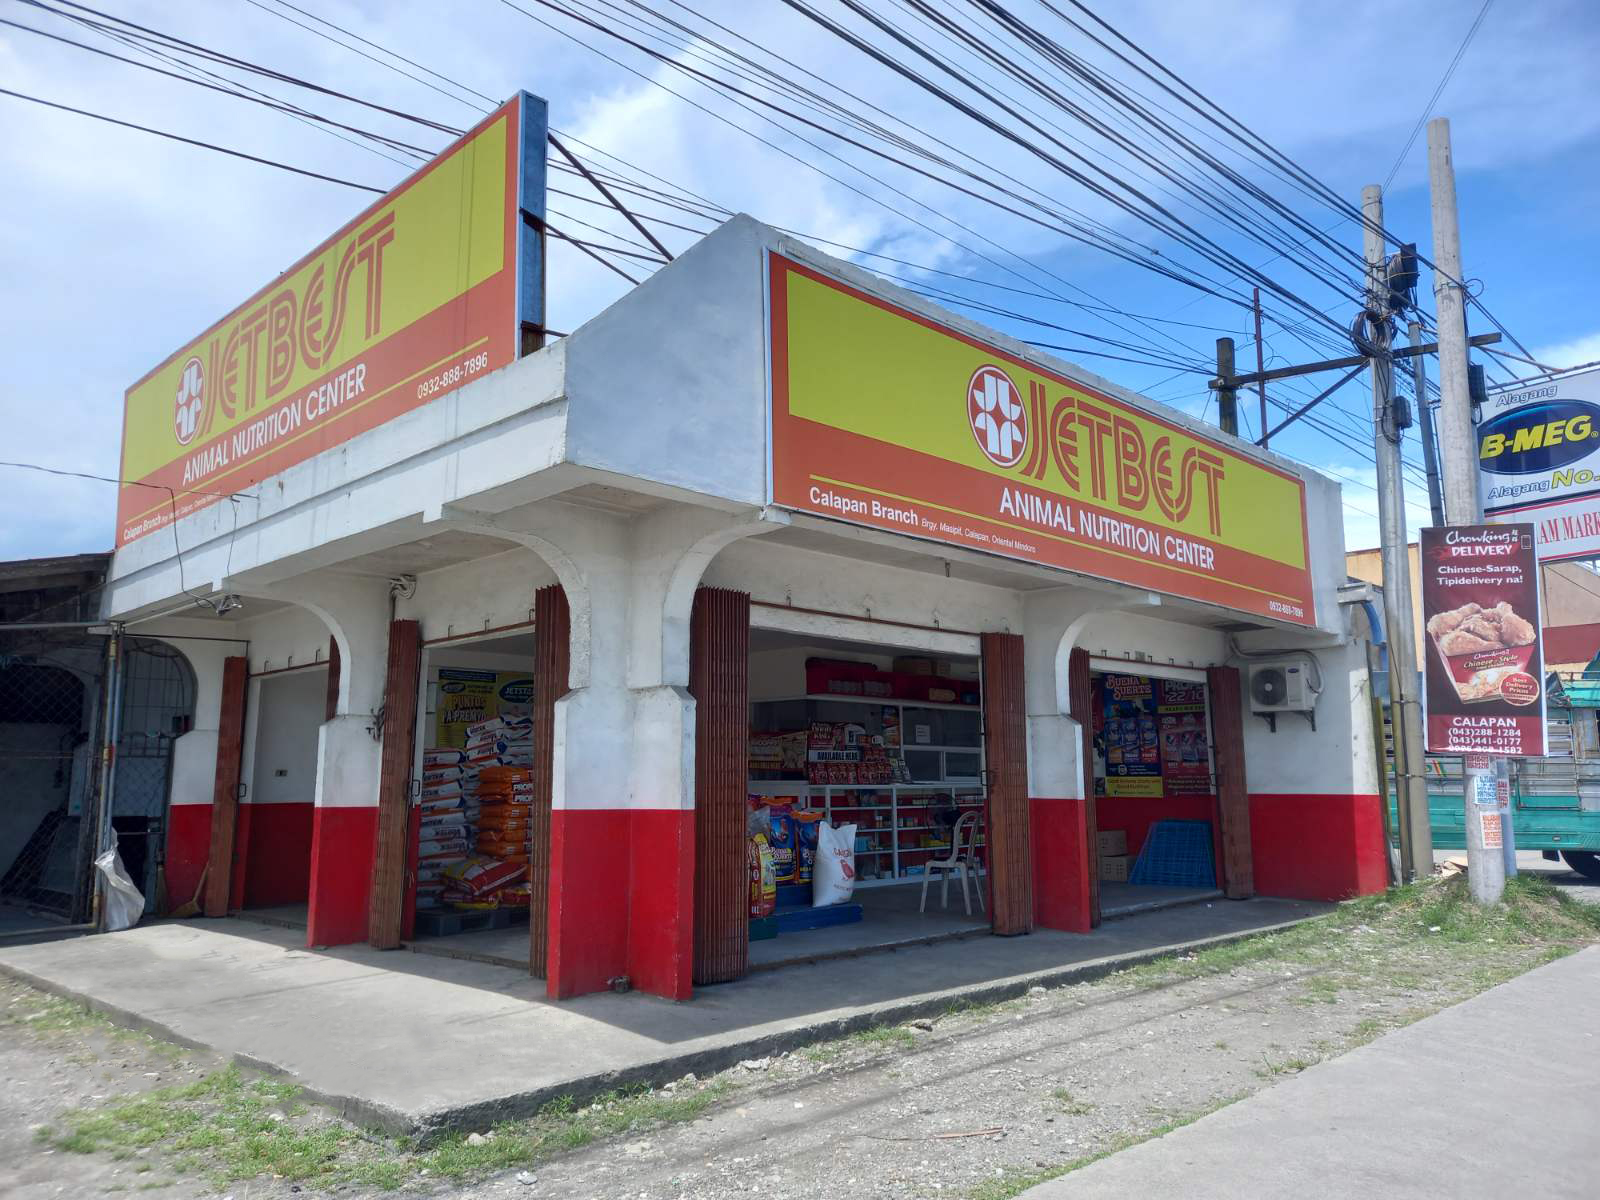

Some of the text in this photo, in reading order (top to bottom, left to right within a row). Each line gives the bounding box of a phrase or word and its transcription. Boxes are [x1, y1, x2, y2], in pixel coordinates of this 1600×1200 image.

[198, 211, 395, 438] JETBEST
[417, 352, 488, 399] 0932-888-7896
[1496, 385, 1557, 407] Alagang
[183, 363, 366, 486] ANIMAL NUTRITION CENTER
[1020, 380, 1225, 537] JETBEST
[1488, 480, 1549, 499] Alagang
[143, 513, 161, 532] Branch
[809, 487, 867, 514] Calapan
[872, 500, 918, 526] Branch
[921, 518, 938, 532] Brgy.
[965, 528, 991, 543] Calapan,
[1000, 487, 1214, 571] ANIMAL NUTRITION CENTER
[1446, 530, 1510, 545] Chowking
[1451, 545, 1512, 556] DELIVERY
[1438, 565, 1522, 574] Chinese-Sarap,
[1436, 575, 1523, 587] Tipidelivery na!
[1453, 717, 1516, 728] CALAPAN
[1448, 728, 1521, 737] (043)288-1284
[1448, 736, 1521, 746] (043)441-0177
